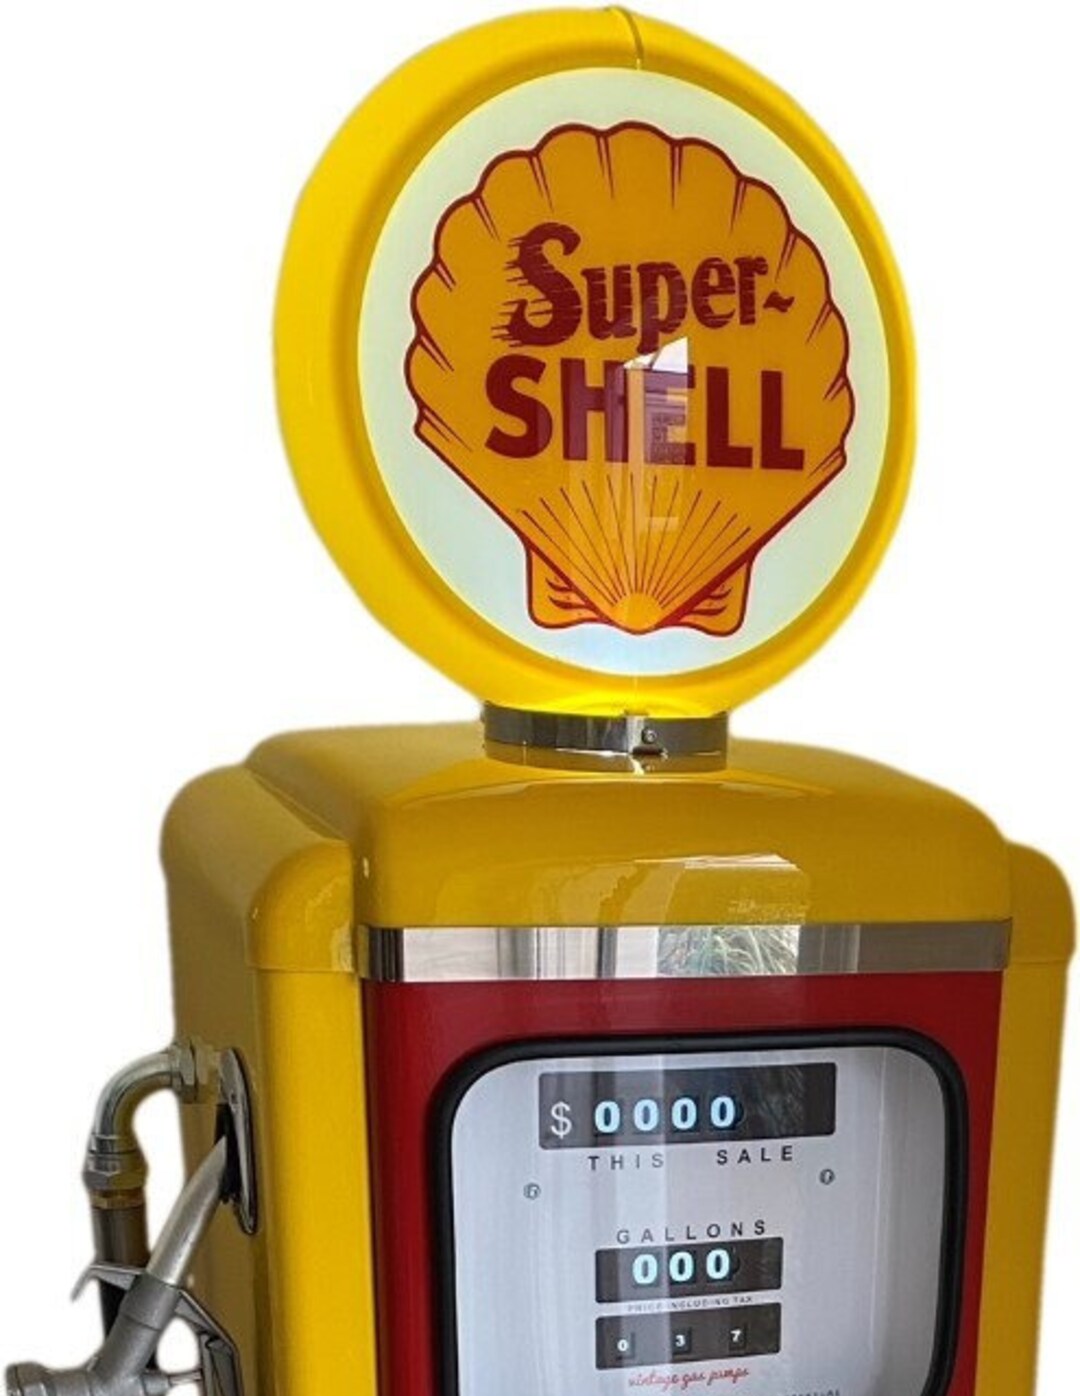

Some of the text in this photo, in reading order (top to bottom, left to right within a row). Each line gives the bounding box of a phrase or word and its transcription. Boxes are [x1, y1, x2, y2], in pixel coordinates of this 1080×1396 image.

[484, 353, 806, 471] SHELL
[550, 1101, 573, 1138] $
[587, 1145, 794, 1171] THIS SALE
[616, 1219, 766, 1245] GALLONS
[632, 1248, 730, 1285] 000
[627, 1295, 753, 1313] PRICE INCLUDING TAX
[628, 1366, 750, 1391] vintage gas pumps
